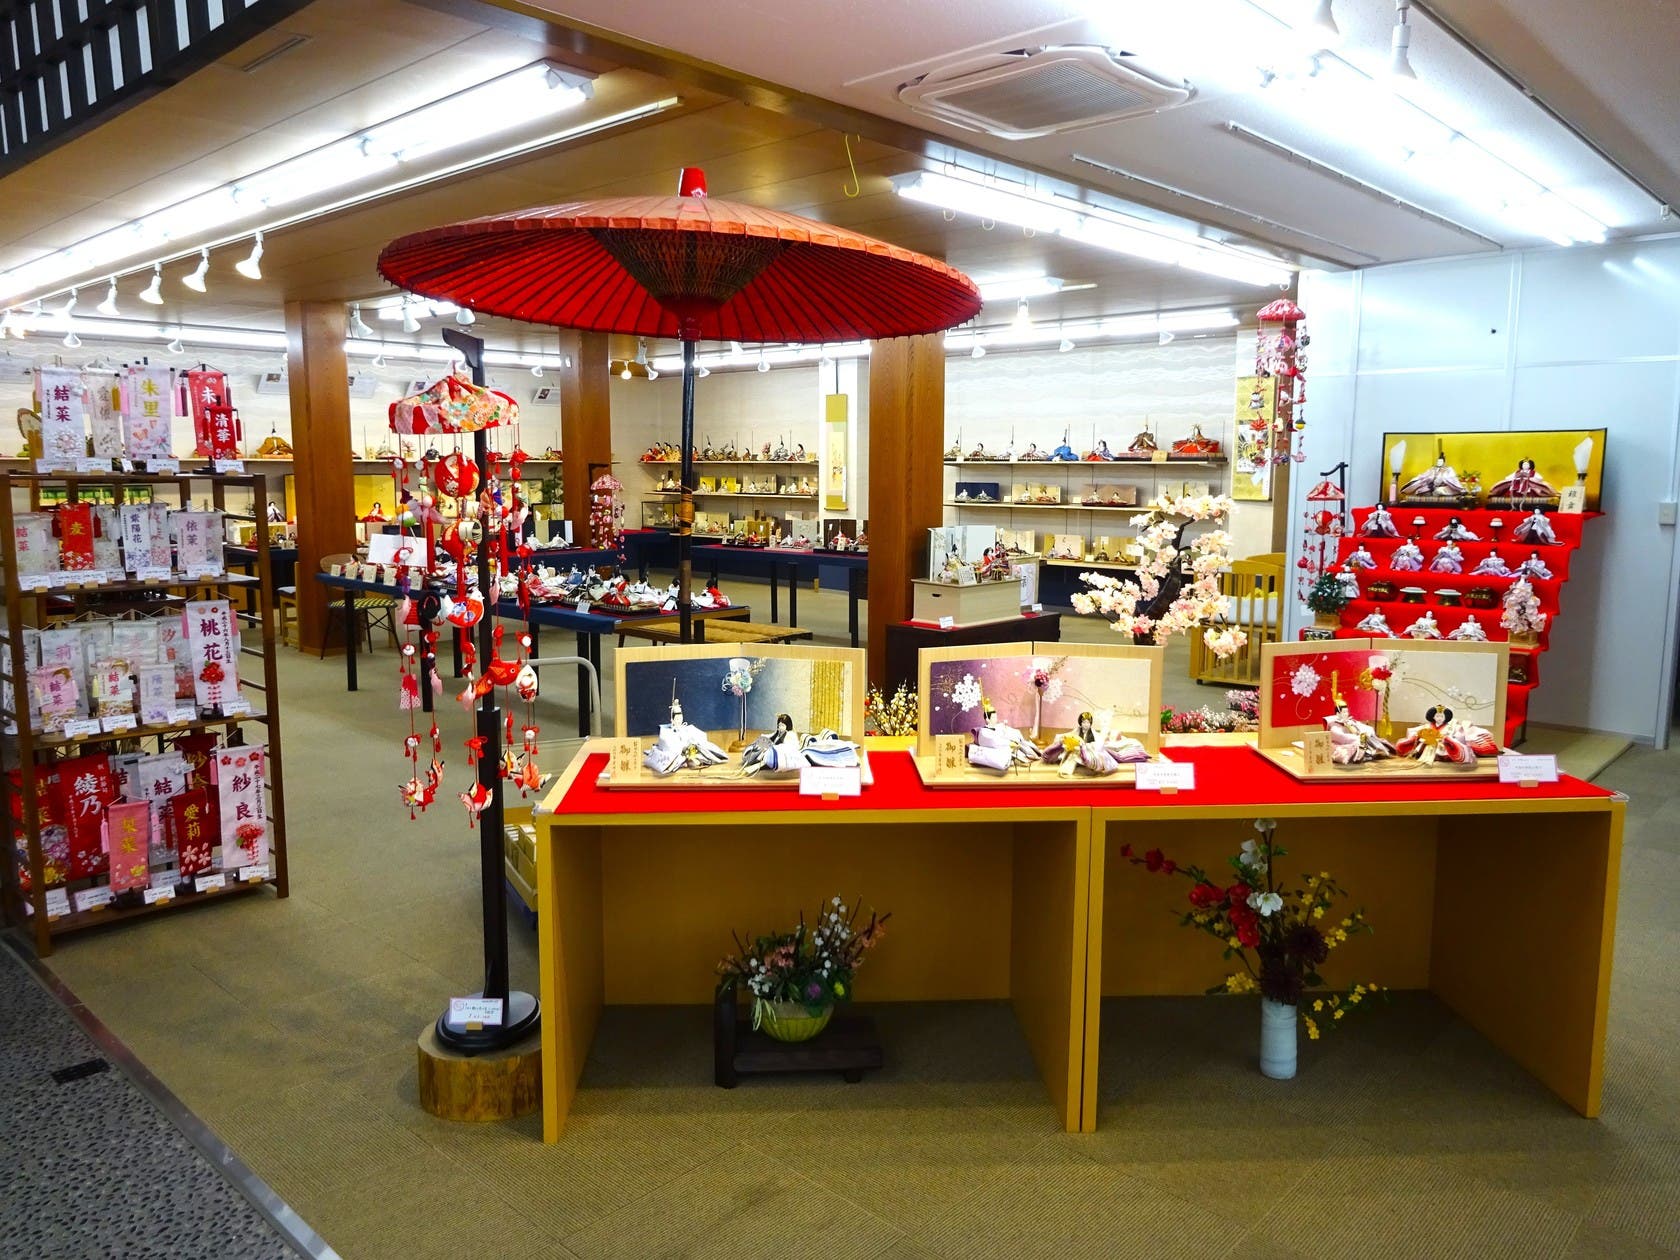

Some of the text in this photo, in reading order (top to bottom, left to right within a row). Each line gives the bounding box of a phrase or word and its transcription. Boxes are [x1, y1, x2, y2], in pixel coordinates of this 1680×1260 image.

[54, 385, 71, 422] 結菜
[200, 619, 224, 661] 桃花
[73, 773, 102, 818] 綾乃
[232, 773, 254, 821] 紗良
[183, 803, 201, 841] 愛莉
